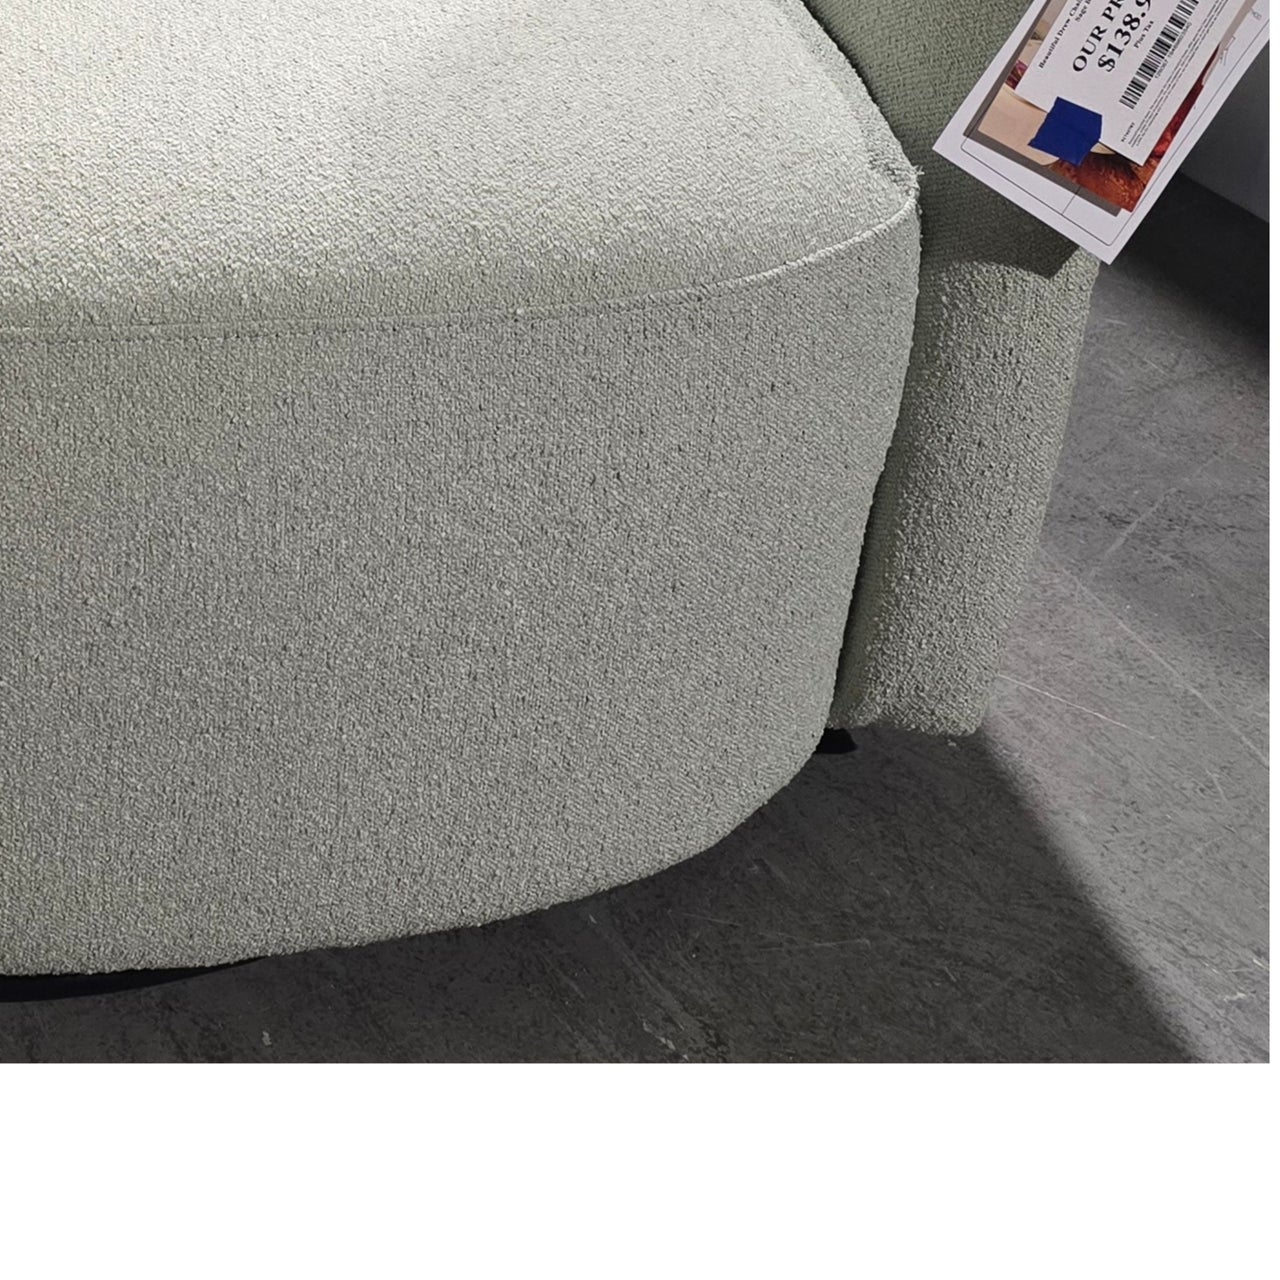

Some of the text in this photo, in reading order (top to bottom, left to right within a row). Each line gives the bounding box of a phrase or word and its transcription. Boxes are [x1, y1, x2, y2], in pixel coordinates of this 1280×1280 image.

[1038, 37, 1059, 69] Beautiful
[1057, 18, 1070, 37] Drew
[1072, 25, 1108, 72] OUR
[1133, 20, 1154, 49] Plus Tax
